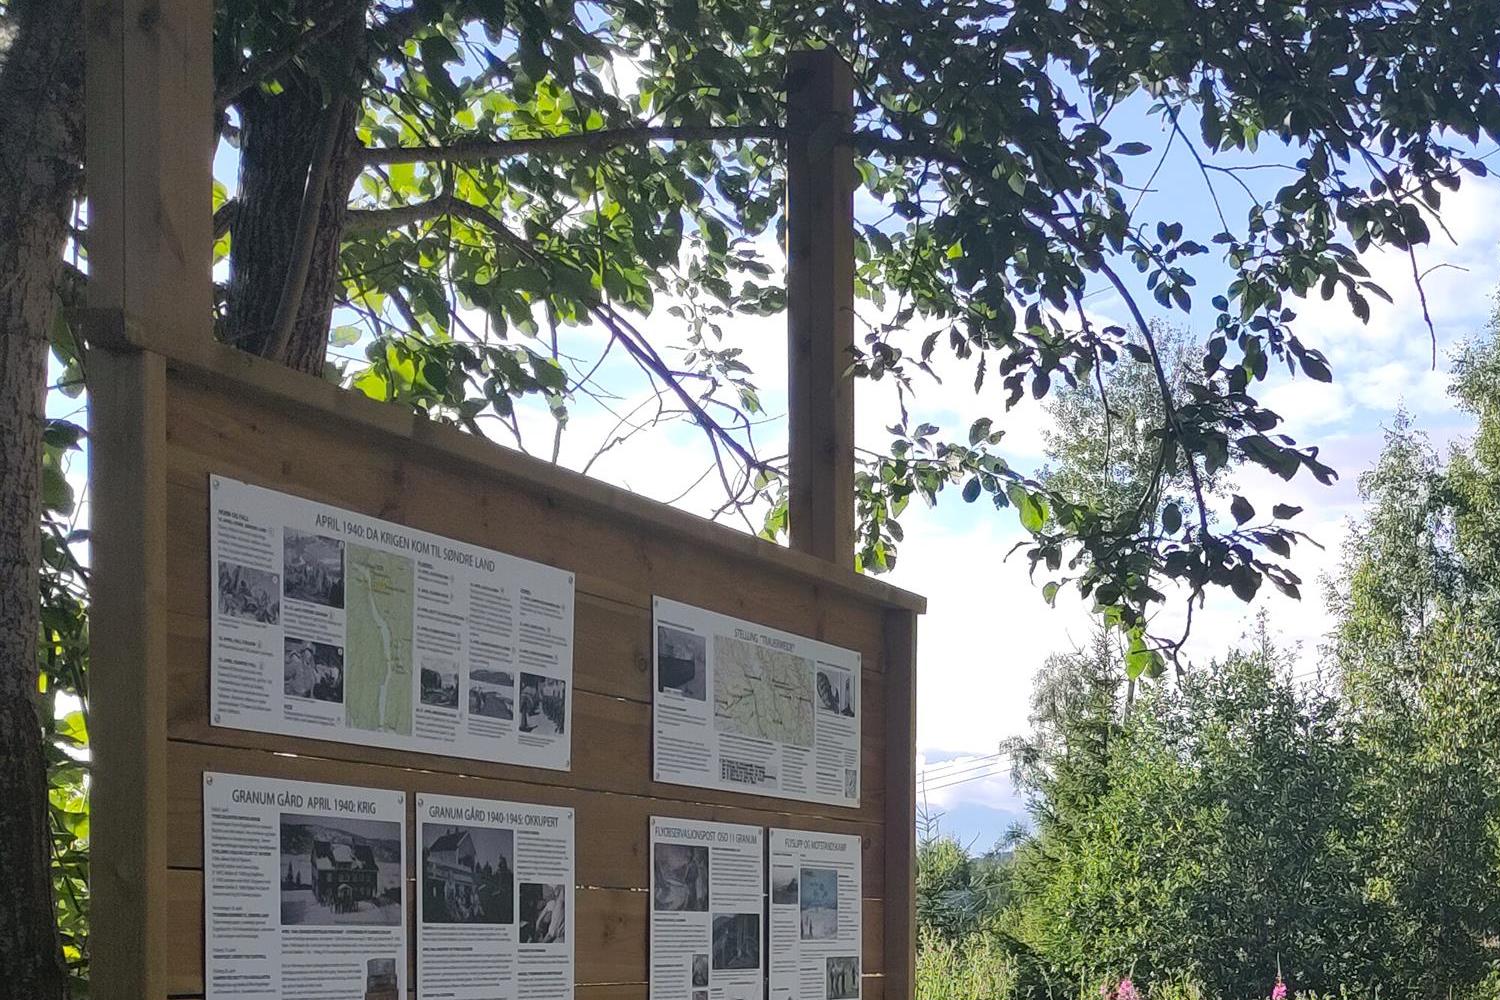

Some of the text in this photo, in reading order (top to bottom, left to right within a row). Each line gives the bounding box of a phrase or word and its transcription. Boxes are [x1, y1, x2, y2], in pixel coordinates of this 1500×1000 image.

[315, 514, 496, 573] APRIL 1940: DA KRIGEN KOM TIL SØNDRE LAND
[232, 789, 376, 815] GRANUM GÅRD APRIL 1940: KRIG
[429, 806, 463, 820] GRANUM
[464, 806, 485, 822] GÅRD
[524, 814, 559, 828] OKKUPERT
